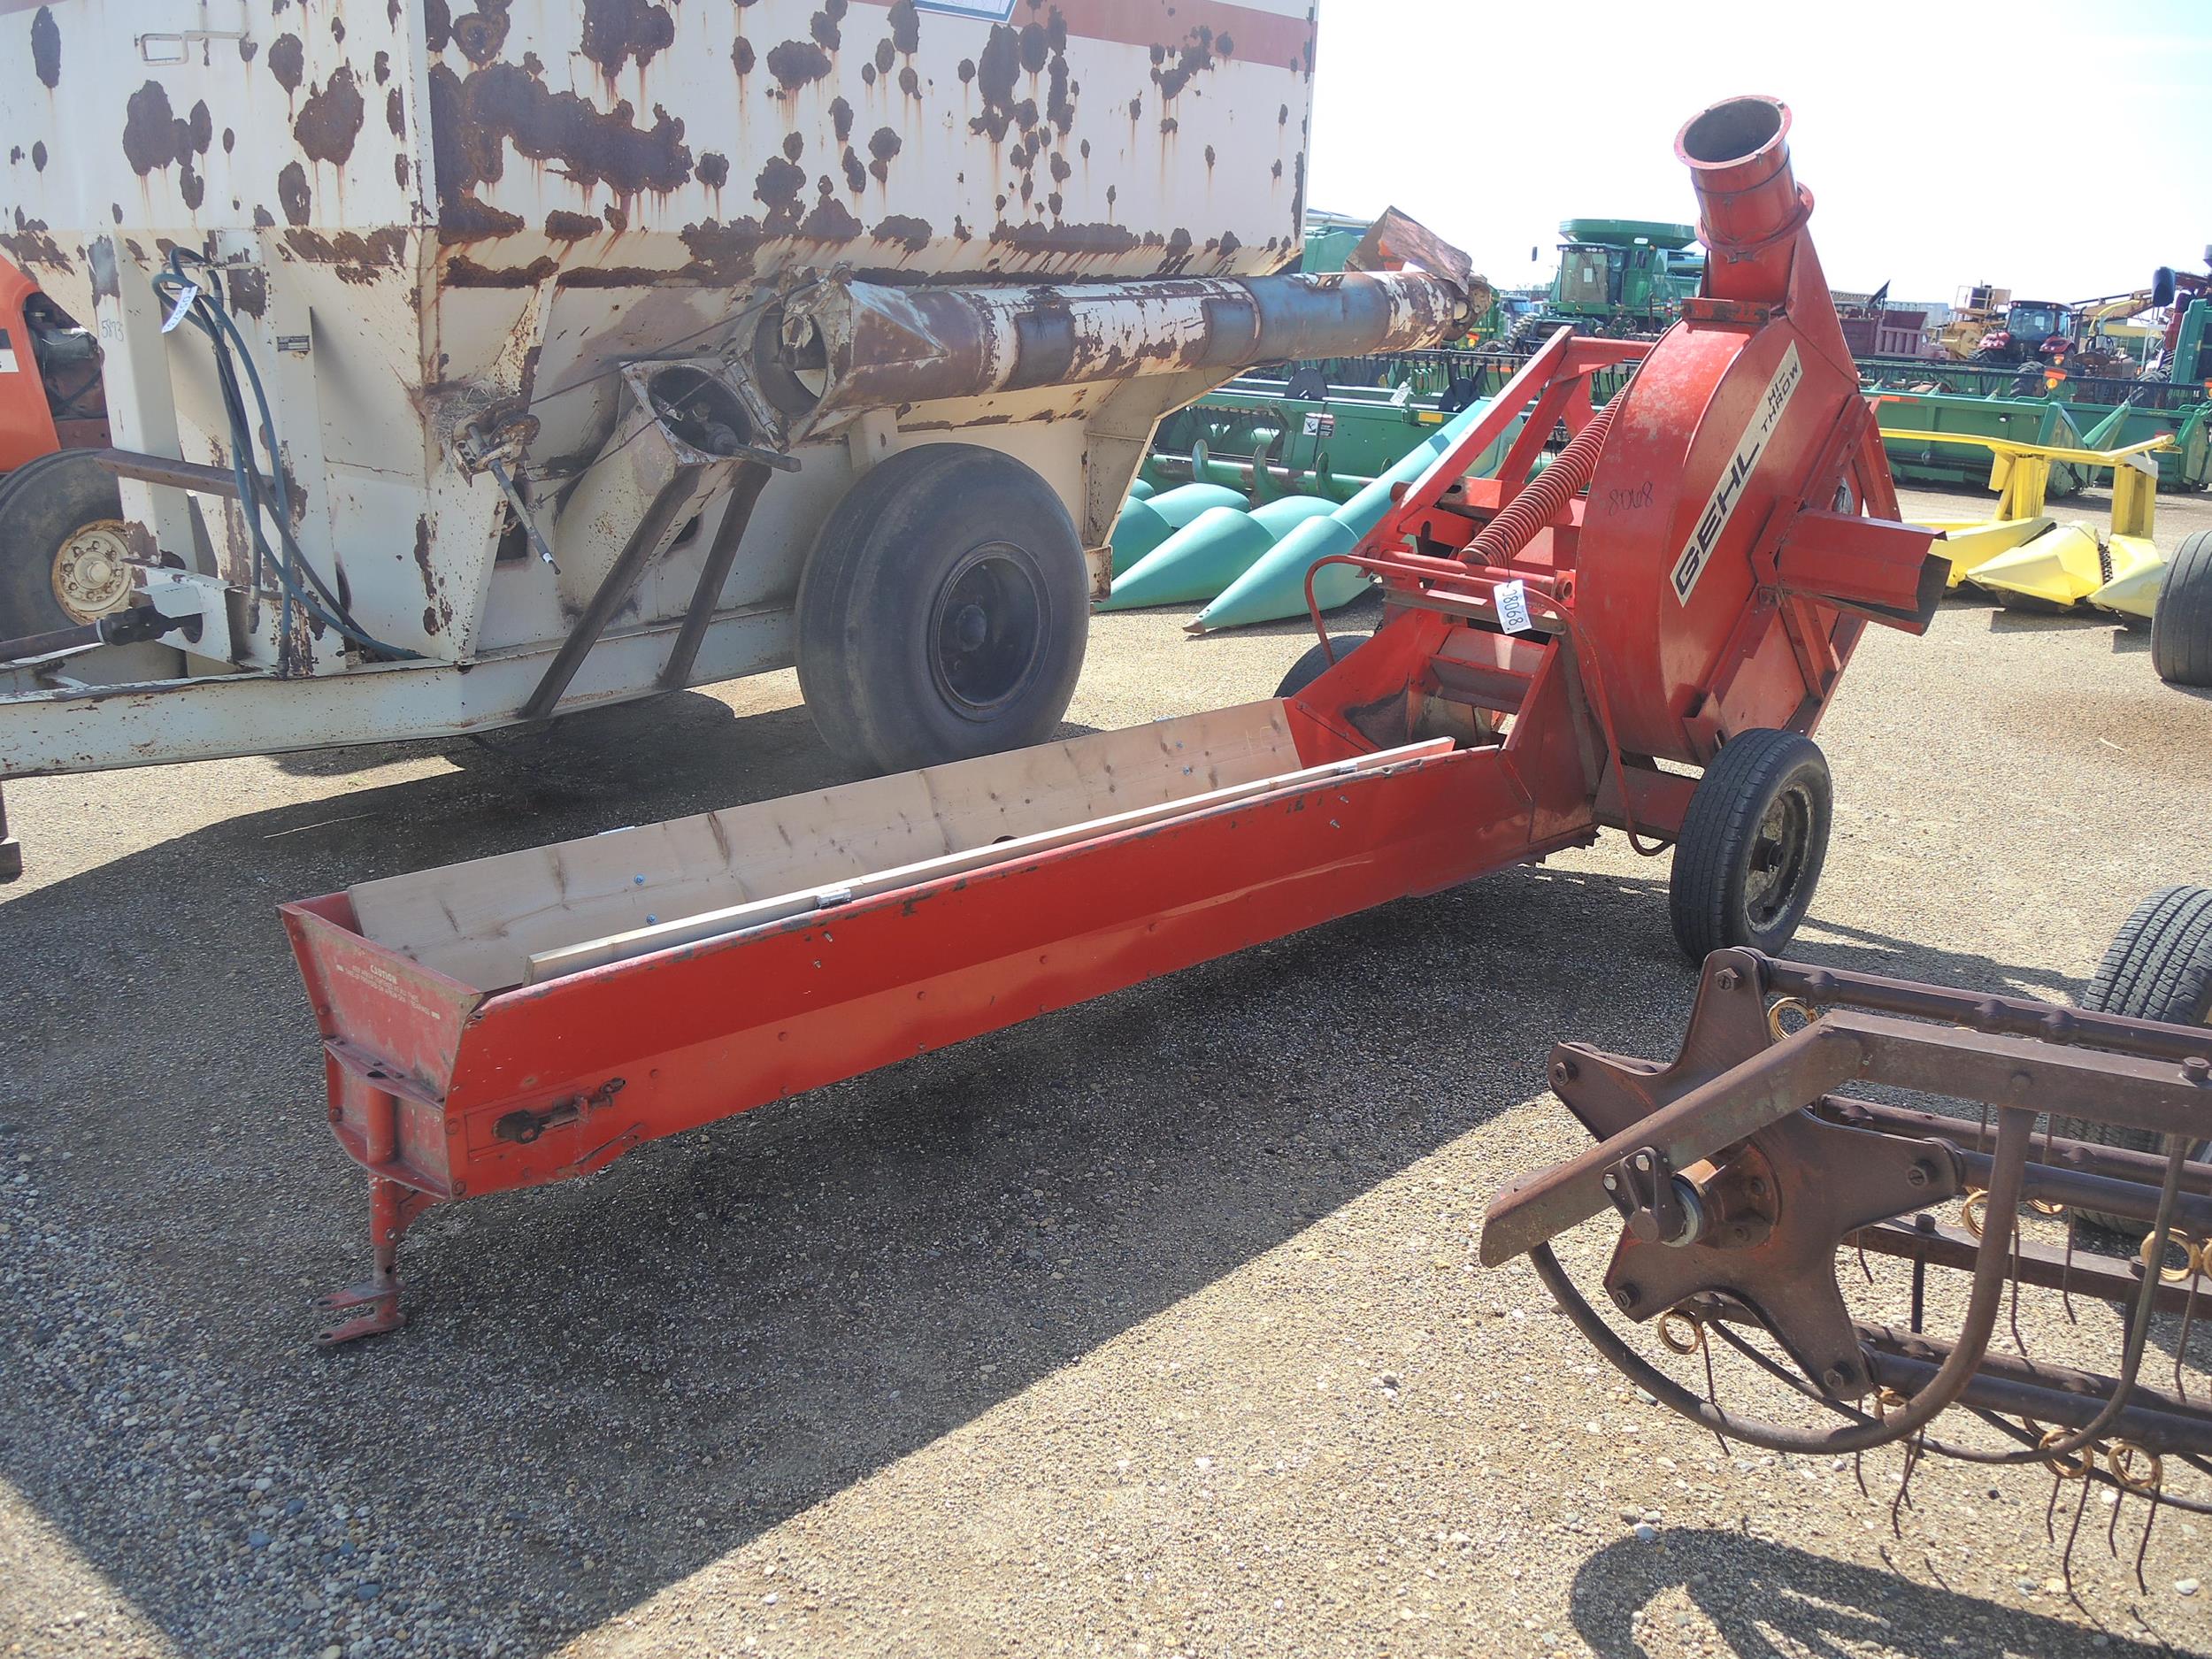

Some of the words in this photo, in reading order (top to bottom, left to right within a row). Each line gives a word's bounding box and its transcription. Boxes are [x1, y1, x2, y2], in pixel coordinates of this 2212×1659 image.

[1761, 361, 1798, 433] THROW
[1608, 480, 1654, 517] 8068
[1675, 442, 1761, 596] GEHL
